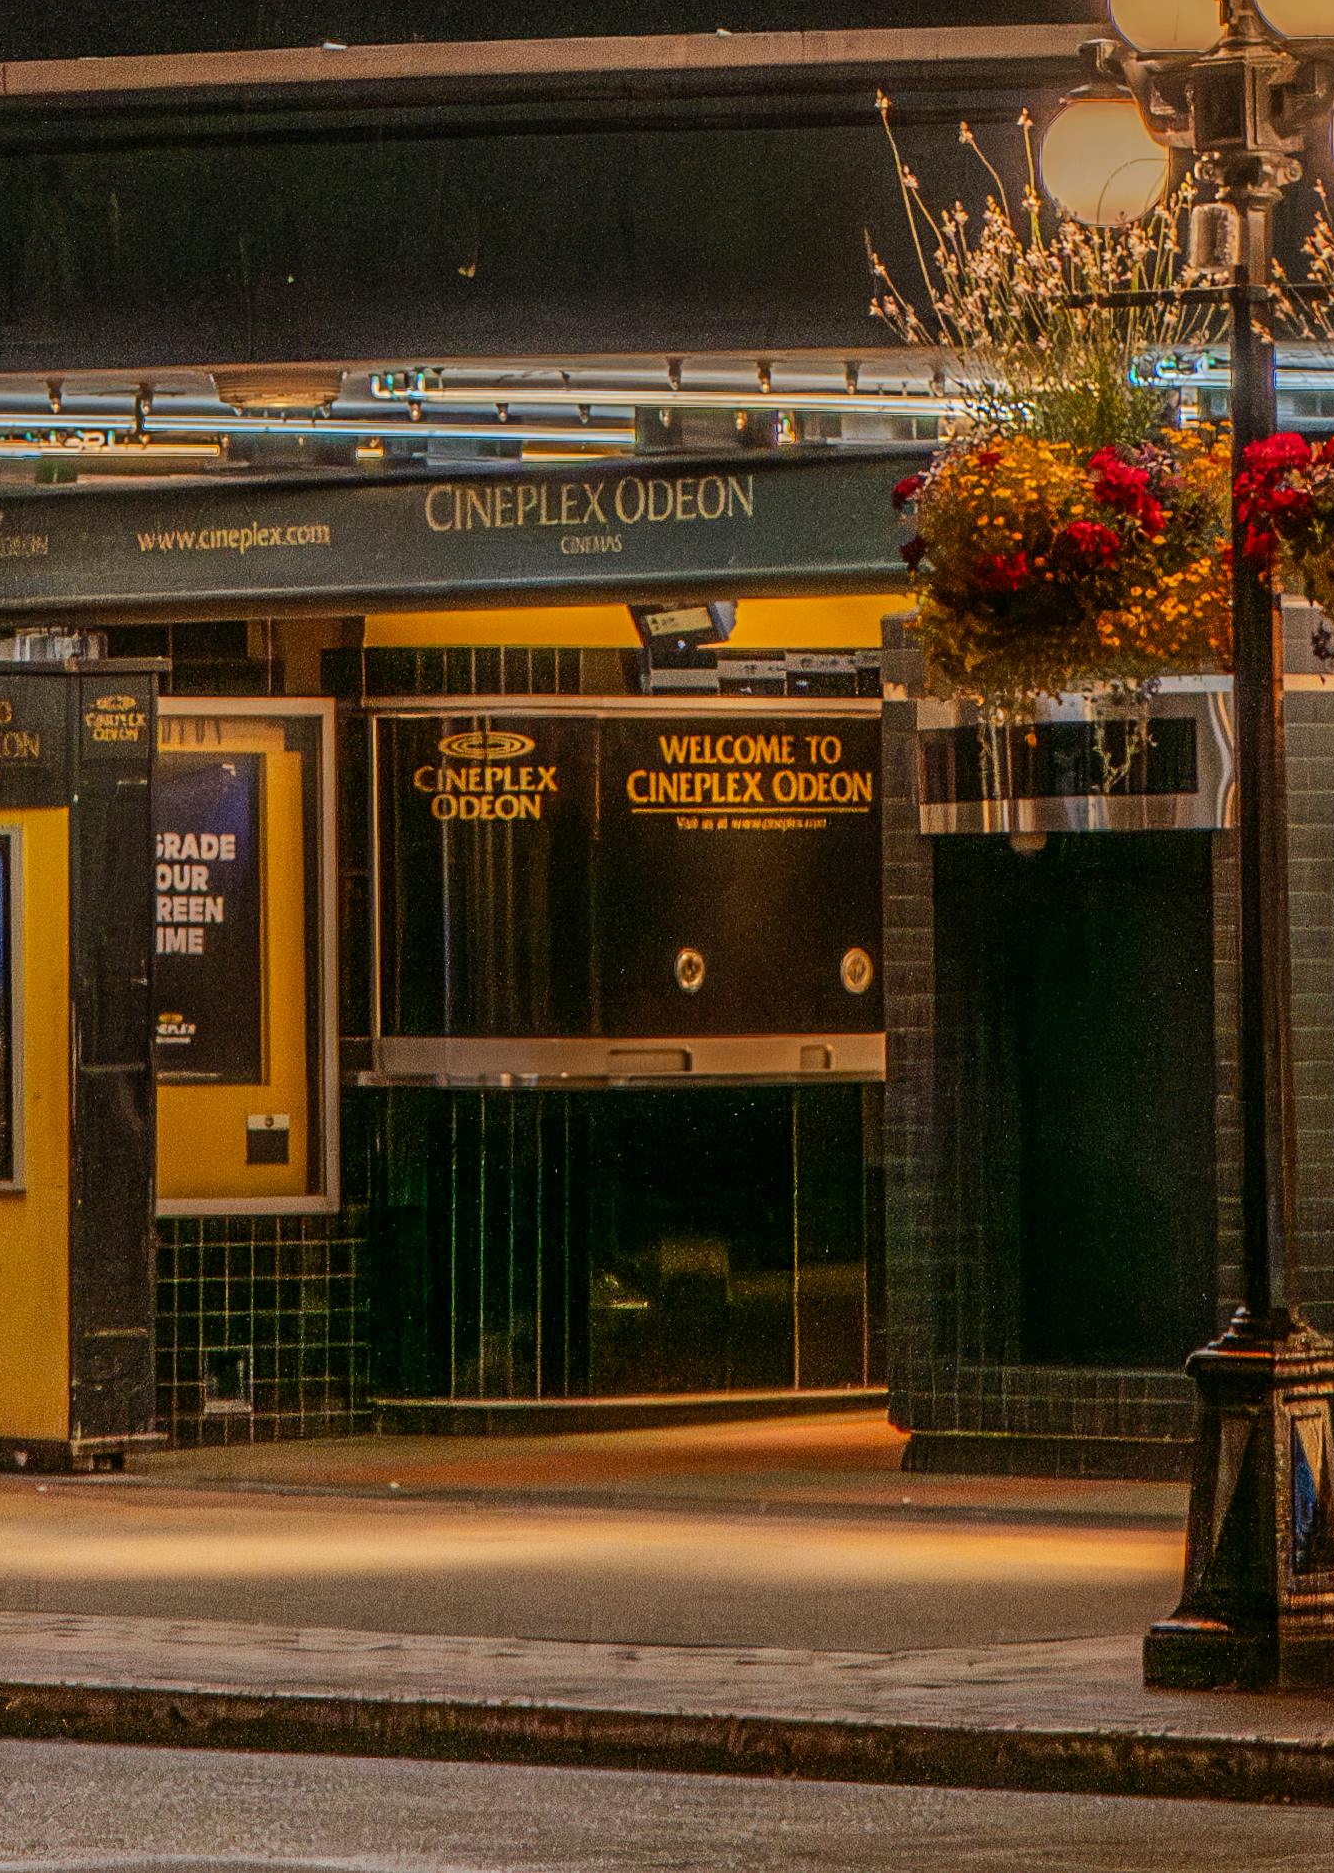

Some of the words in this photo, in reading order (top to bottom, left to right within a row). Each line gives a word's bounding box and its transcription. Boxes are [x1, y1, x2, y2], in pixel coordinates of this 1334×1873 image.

[425, 481, 607, 532] CINEPLEX
[615, 474, 754, 524] ODEON
[137, 521, 331, 554] www.cineplex.com
[561, 534, 622, 554] CINEMAS
[659, 735, 795, 764] WELCOME
[806, 735, 842, 764] TO
[413, 765, 559, 792] CINEPLEX
[626, 769, 764, 803] CINEPLEX
[772, 769, 873, 802] ODEON
[431, 793, 541, 820] ODEON
[157, 895, 224, 923] REEN
[156, 926, 204, 954] IME
